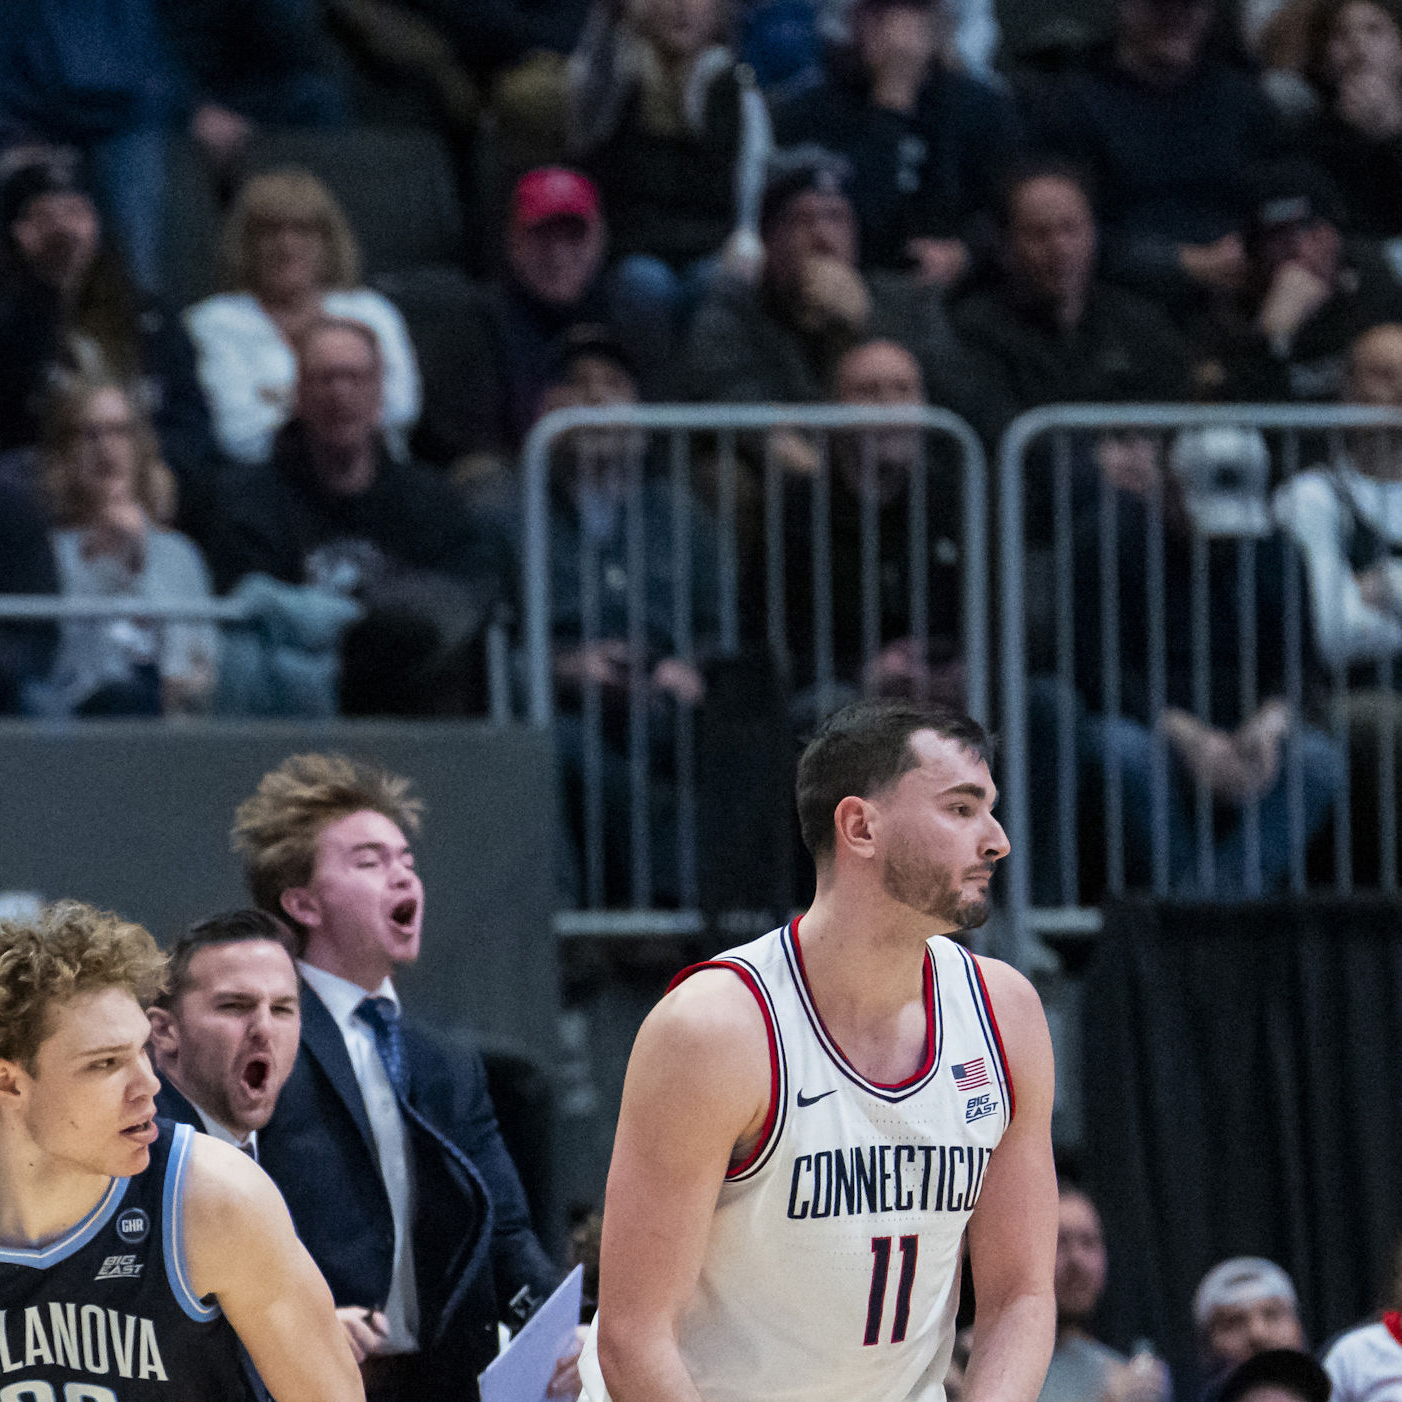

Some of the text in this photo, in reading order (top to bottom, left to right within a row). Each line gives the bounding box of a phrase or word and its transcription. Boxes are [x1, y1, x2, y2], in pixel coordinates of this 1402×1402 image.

[967, 1093, 991, 1109] BIG
[965, 1101, 999, 1120] EAST
[121, 1218, 145, 1234] GHR
[103, 1254, 136, 1266] BIG
[98, 1263, 144, 1275] EAST
[863, 1234, 920, 1347] 11
